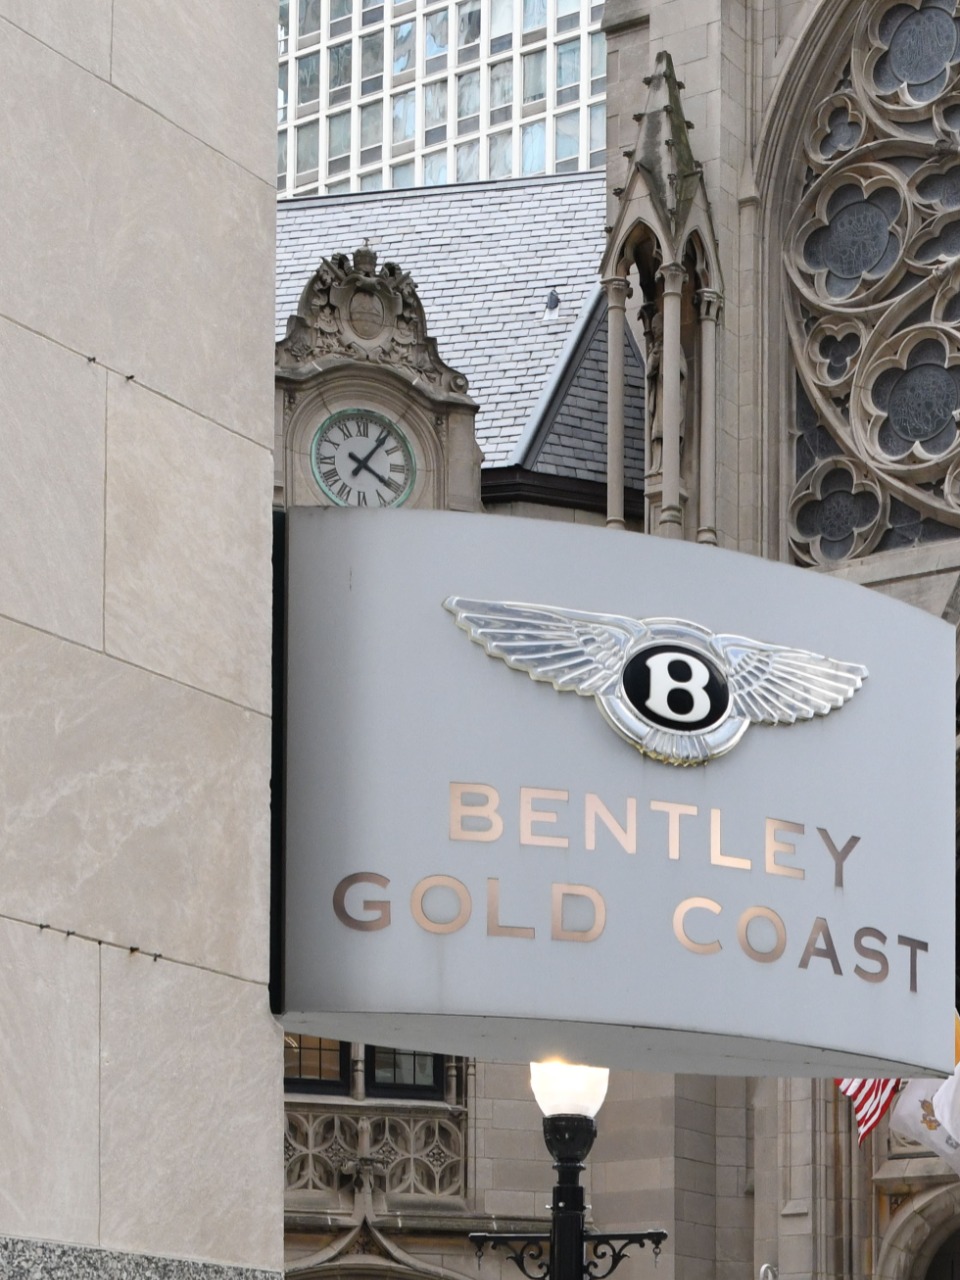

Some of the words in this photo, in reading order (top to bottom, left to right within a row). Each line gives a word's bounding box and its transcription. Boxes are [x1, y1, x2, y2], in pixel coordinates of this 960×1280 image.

[355, 420, 369, 438] XII
[644, 651, 712, 723] B
[448, 781, 861, 888] BENTLEY
[332, 872, 607, 944] GOLD
[672, 896, 929, 994] COAST
